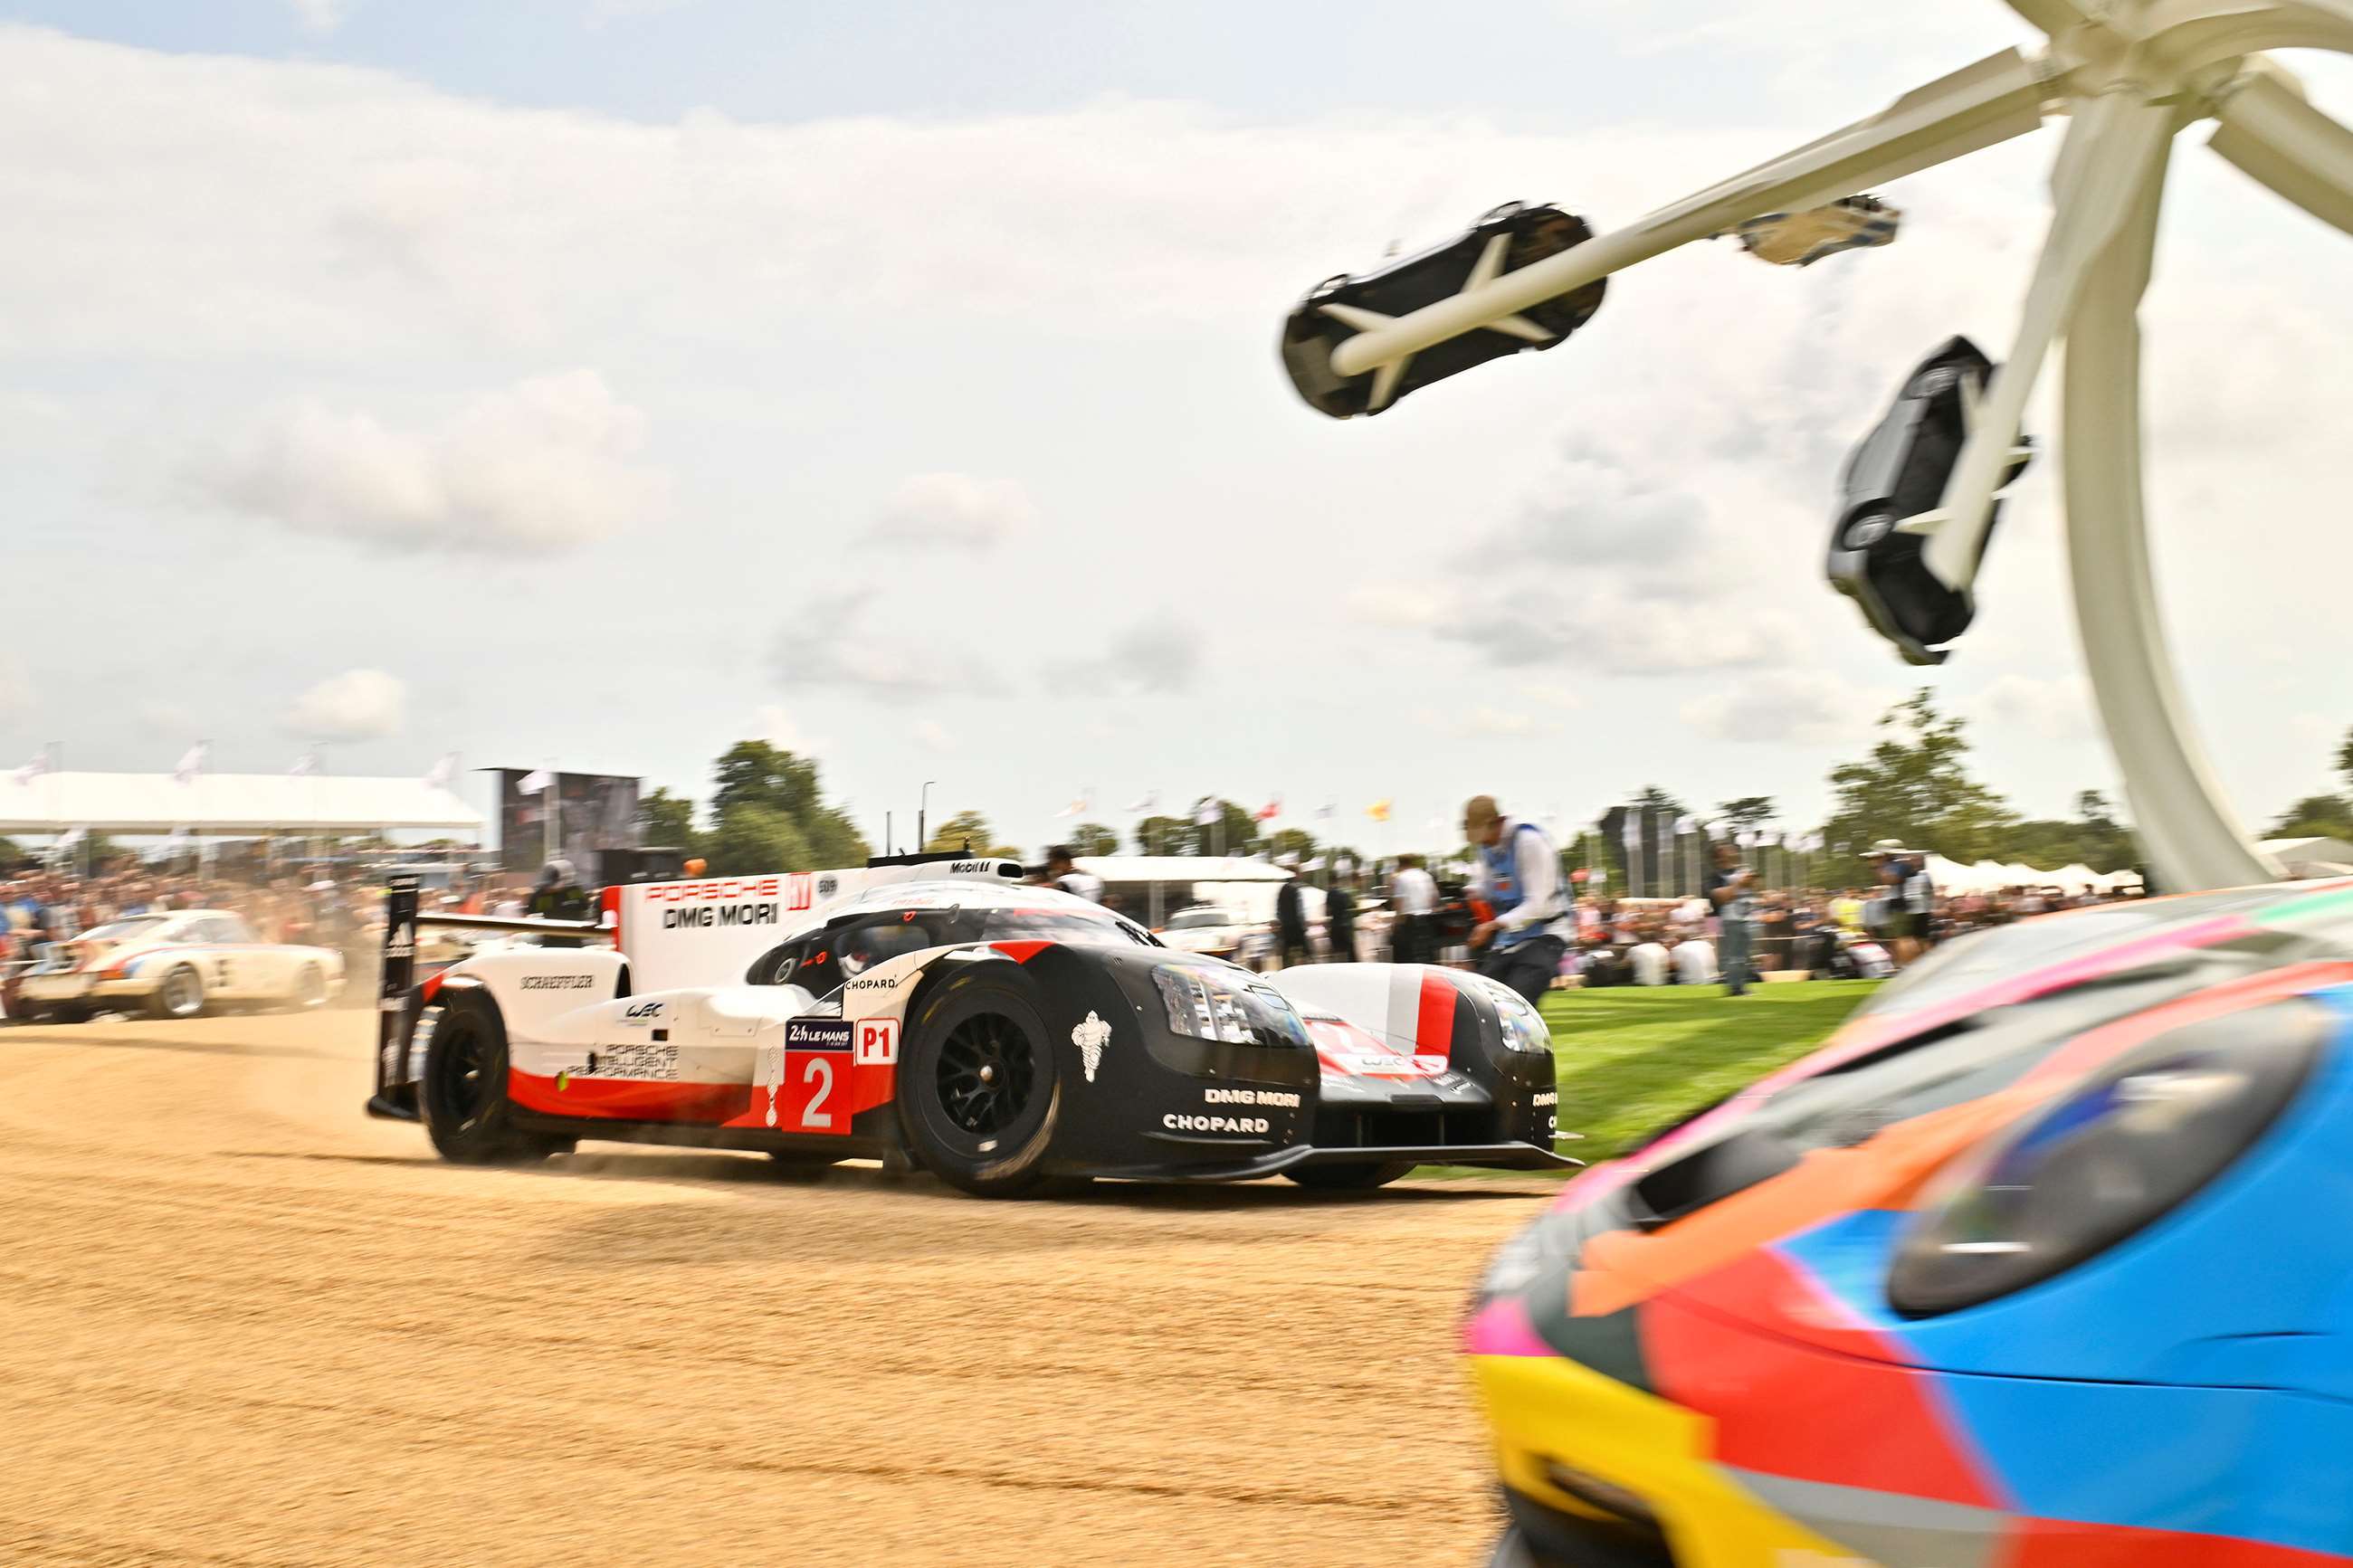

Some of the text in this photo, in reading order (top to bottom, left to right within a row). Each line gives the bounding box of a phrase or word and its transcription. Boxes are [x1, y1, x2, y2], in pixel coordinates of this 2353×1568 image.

[949, 862, 978, 873] Mobil
[646, 879, 779, 902] PORSCHE
[663, 903, 778, 929] DMG MORI
[520, 975, 594, 990] SCHAEFFLER
[845, 979, 895, 990] CHOPARD
[625, 1003, 663, 1018] WEC
[821, 1031, 850, 1041] MANS
[862, 1027, 890, 1058] P1
[605, 1044, 679, 1056] PORSCHE
[801, 1057, 833, 1128] 2
[1205, 1088, 1301, 1108] DMG MORI
[1163, 1114, 1269, 1133] CHOPARD
